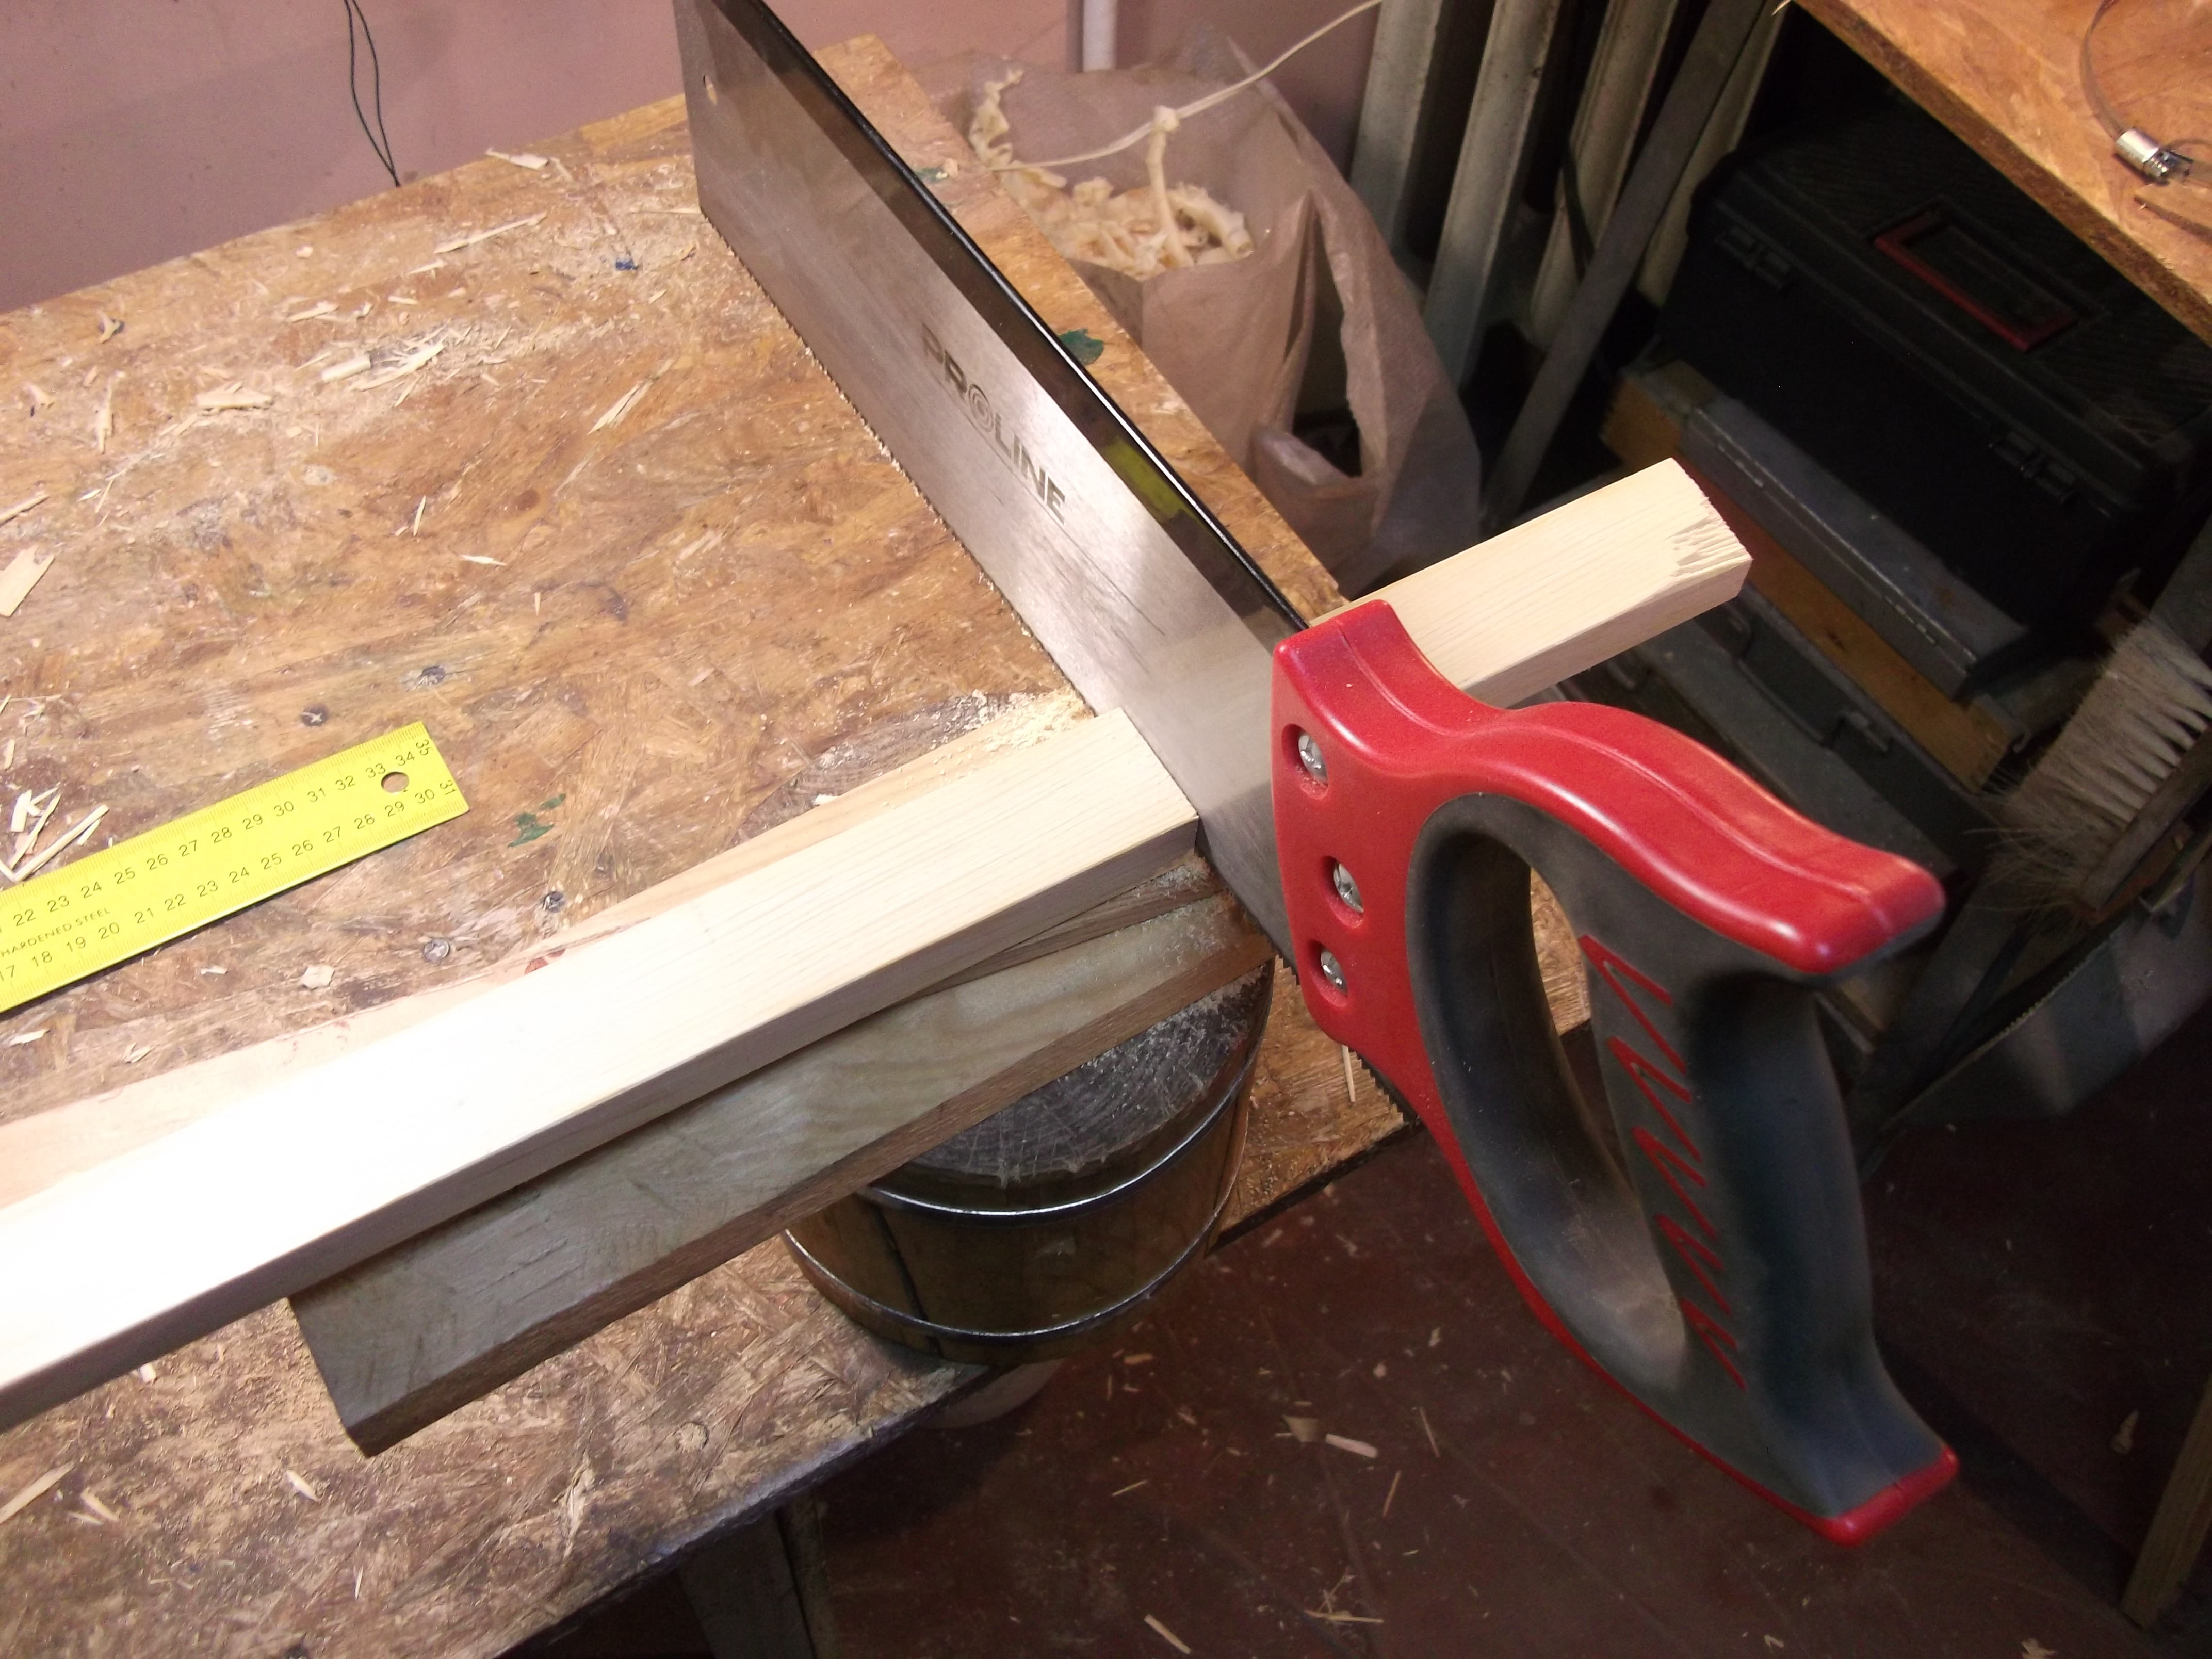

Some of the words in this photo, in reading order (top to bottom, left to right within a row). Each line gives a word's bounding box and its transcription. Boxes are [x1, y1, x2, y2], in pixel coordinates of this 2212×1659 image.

[14, 909, 36, 926] 22
[47, 896, 70, 912] 23
[81, 881, 103, 898] 24
[114, 868, 135, 884] 25
[147, 854, 168, 871] 26
[179, 840, 198, 857] 27
[211, 827, 232, 843] 28
[243, 814, 263, 830] 29
[274, 801, 294, 816] 30
[307, 787, 326, 802] 31
[335, 775, 355, 791] 32
[366, 763, 385, 778] 33
[396, 751, 415, 767] 34
[415, 739, 430, 756] 35
[32, 951, 52, 967] 18
[66, 937, 86, 952] 19
[98, 922, 120, 939] 20
[135, 908, 154, 924] 21
[165, 894, 186, 911] 22
[197, 881, 218, 897] 23
[229, 867, 249, 883] 24
[261, 853, 281, 870] 25
[292, 839, 313, 856] 26
[323, 826, 341, 842] 27
[354, 814, 375, 829] 28
[385, 801, 404, 817] 29
[415, 789, 434, 804] 30
[440, 779, 457, 795] 31
[1, 922, 72, 956] HARDENED
[76, 907, 111, 926] STEEL
